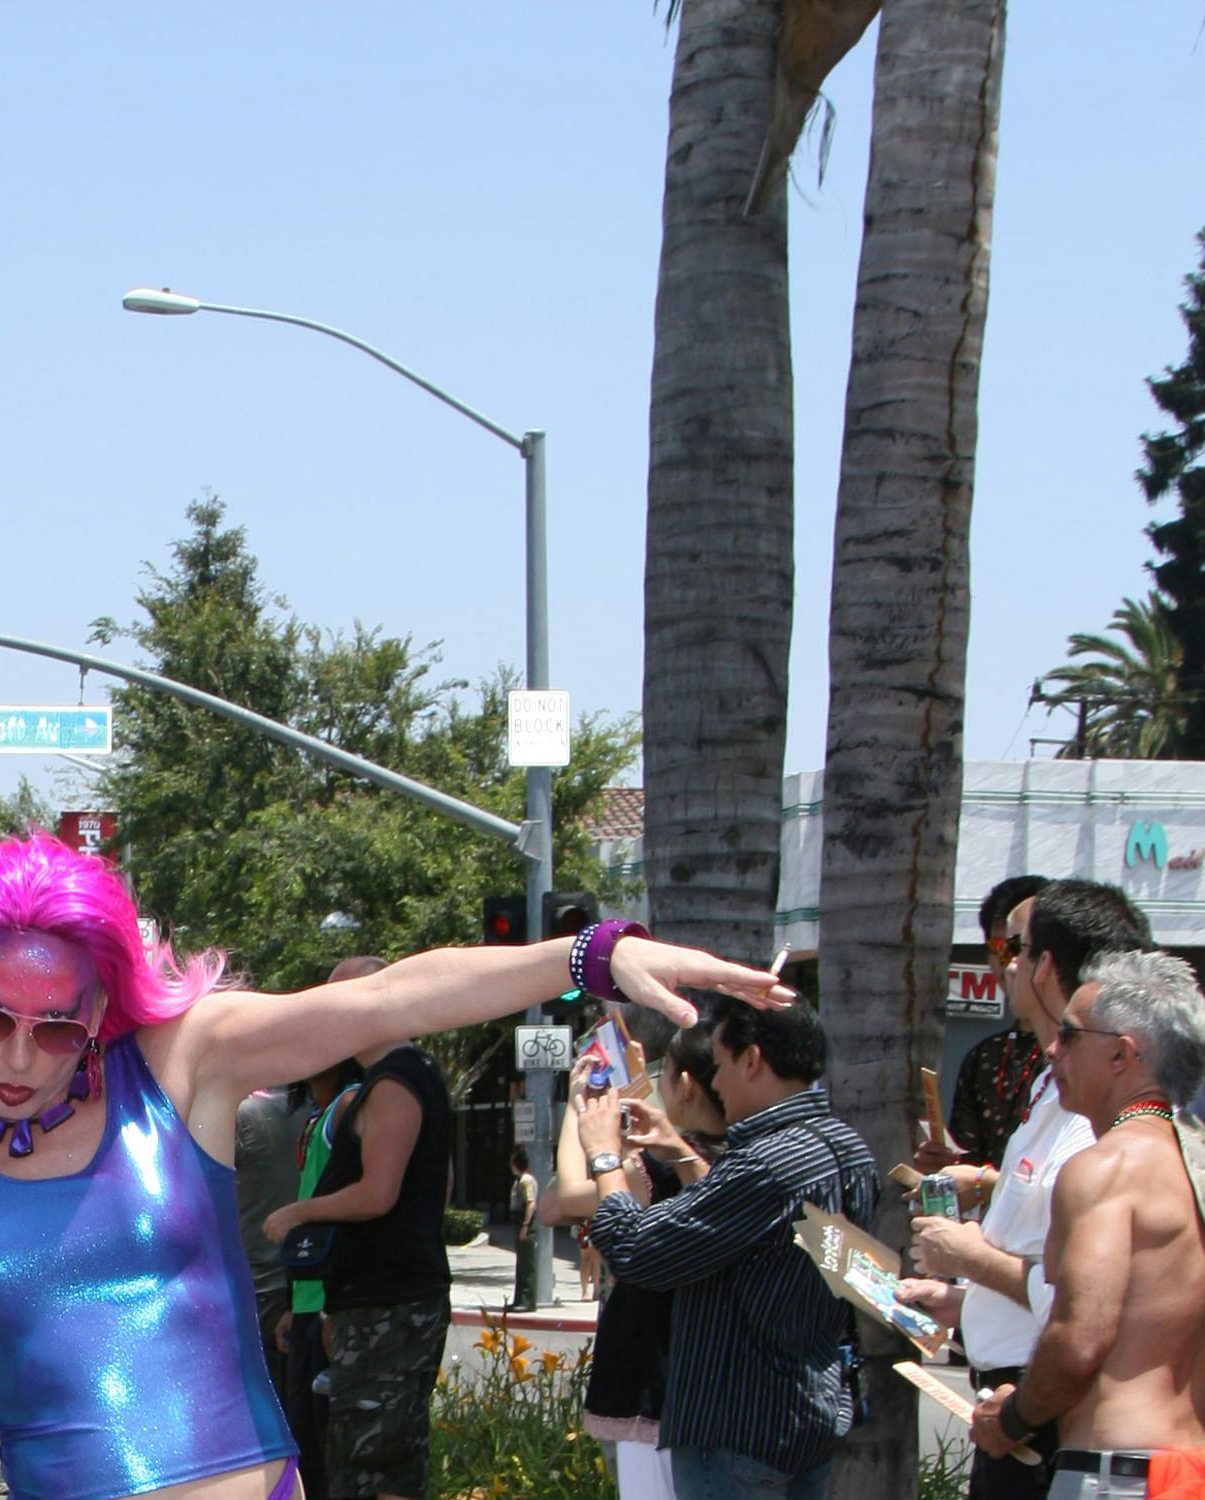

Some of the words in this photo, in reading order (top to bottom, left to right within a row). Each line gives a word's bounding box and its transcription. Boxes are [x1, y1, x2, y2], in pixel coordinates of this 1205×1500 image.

[514, 698, 531, 713] DO
[538, 698, 563, 713] NOT
[514, 718, 564, 733] BLOCK
[78, 819, 101, 830] 1970
